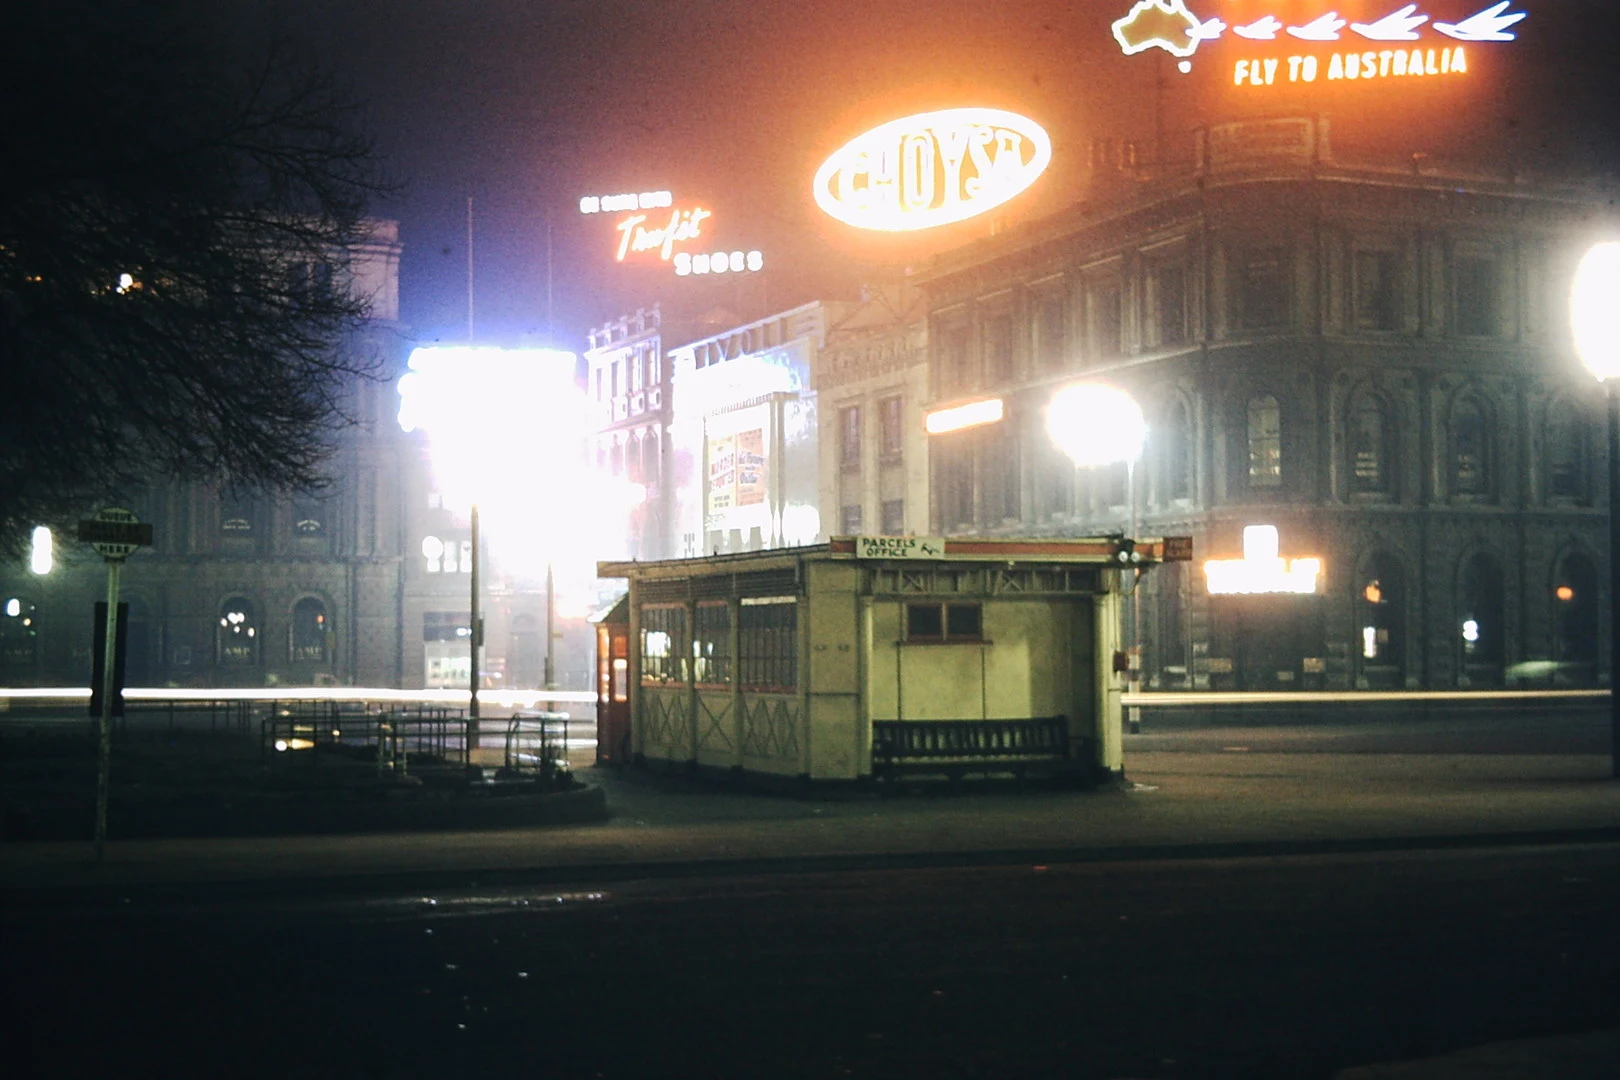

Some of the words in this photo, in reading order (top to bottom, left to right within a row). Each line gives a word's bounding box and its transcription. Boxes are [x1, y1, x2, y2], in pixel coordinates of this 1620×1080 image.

[1234, 59, 1278, 86] FLY
[1287, 55, 1318, 83] TO
[1327, 47, 1467, 80] AUSTRALIA
[836, 122, 1030, 214] CHOYSA
[862, 538, 916, 548] PARCELS
[99, 545, 129, 553] HERE
[866, 548, 908, 557] OFFICE
